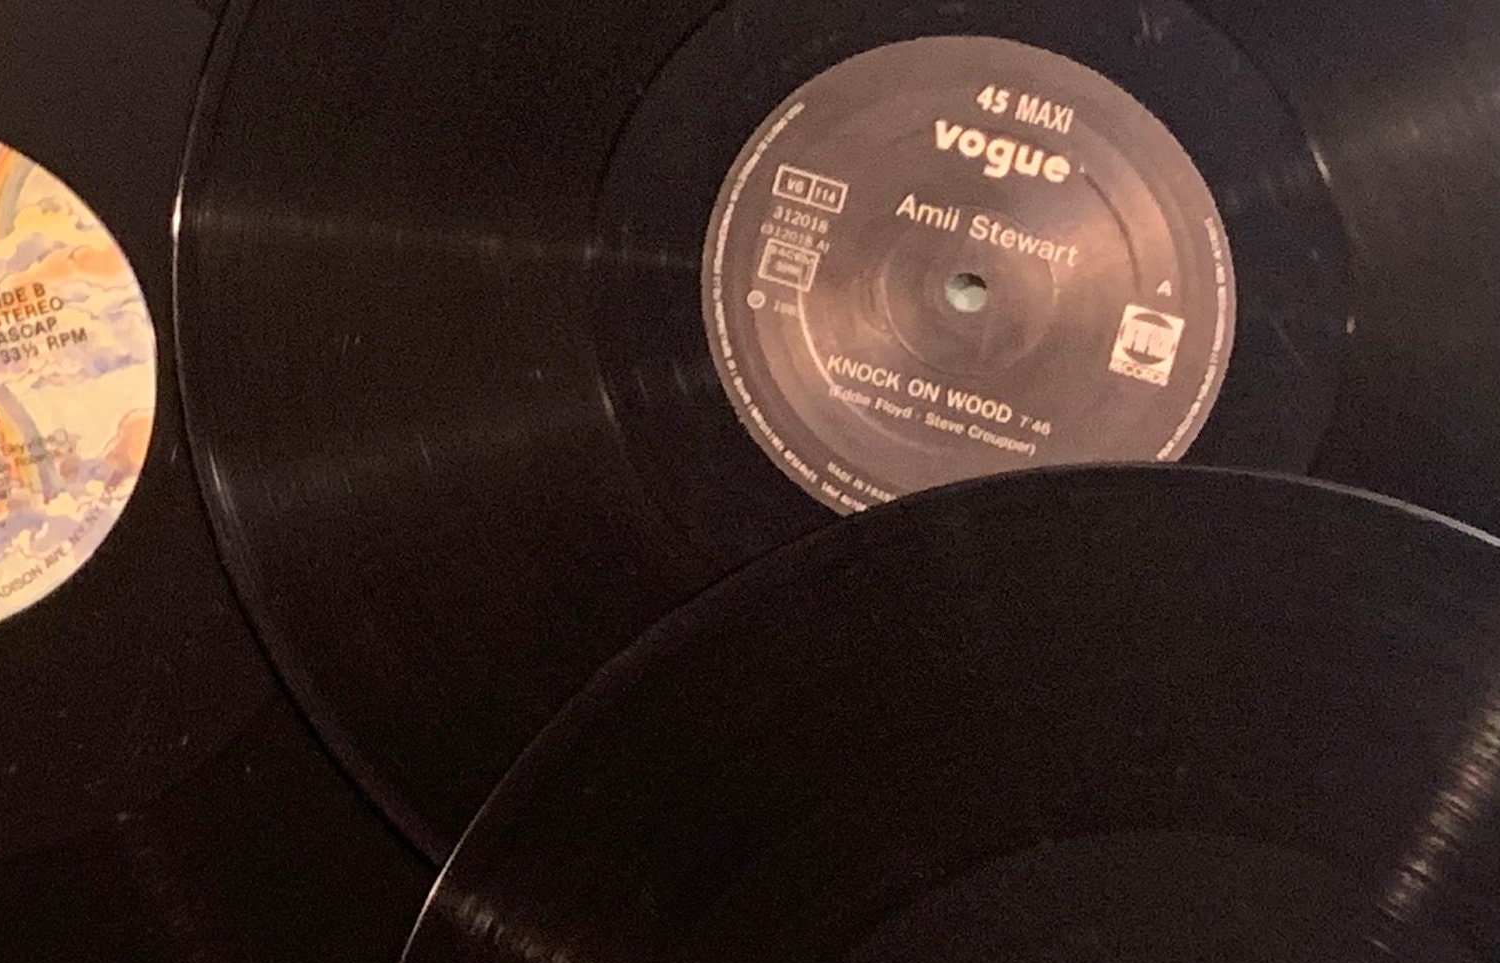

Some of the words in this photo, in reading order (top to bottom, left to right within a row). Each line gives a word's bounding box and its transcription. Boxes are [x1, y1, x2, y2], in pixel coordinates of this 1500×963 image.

[976, 83, 1010, 114] 45
[1015, 93, 1074, 134] MAXI
[934, 119, 1071, 183] vogue
[895, 192, 961, 232] Amii
[968, 214, 1079, 267] Stewart
[32, 282, 46, 298] B
[1156, 280, 1172, 297] A
[46, 327, 88, 350] RPM
[827, 355, 901, 392] KNOCK
[907, 377, 941, 402] ON
[947, 388, 1012, 424] WOOD
[874, 397, 913, 420] Floyd
[924, 412, 966, 436] Steve
